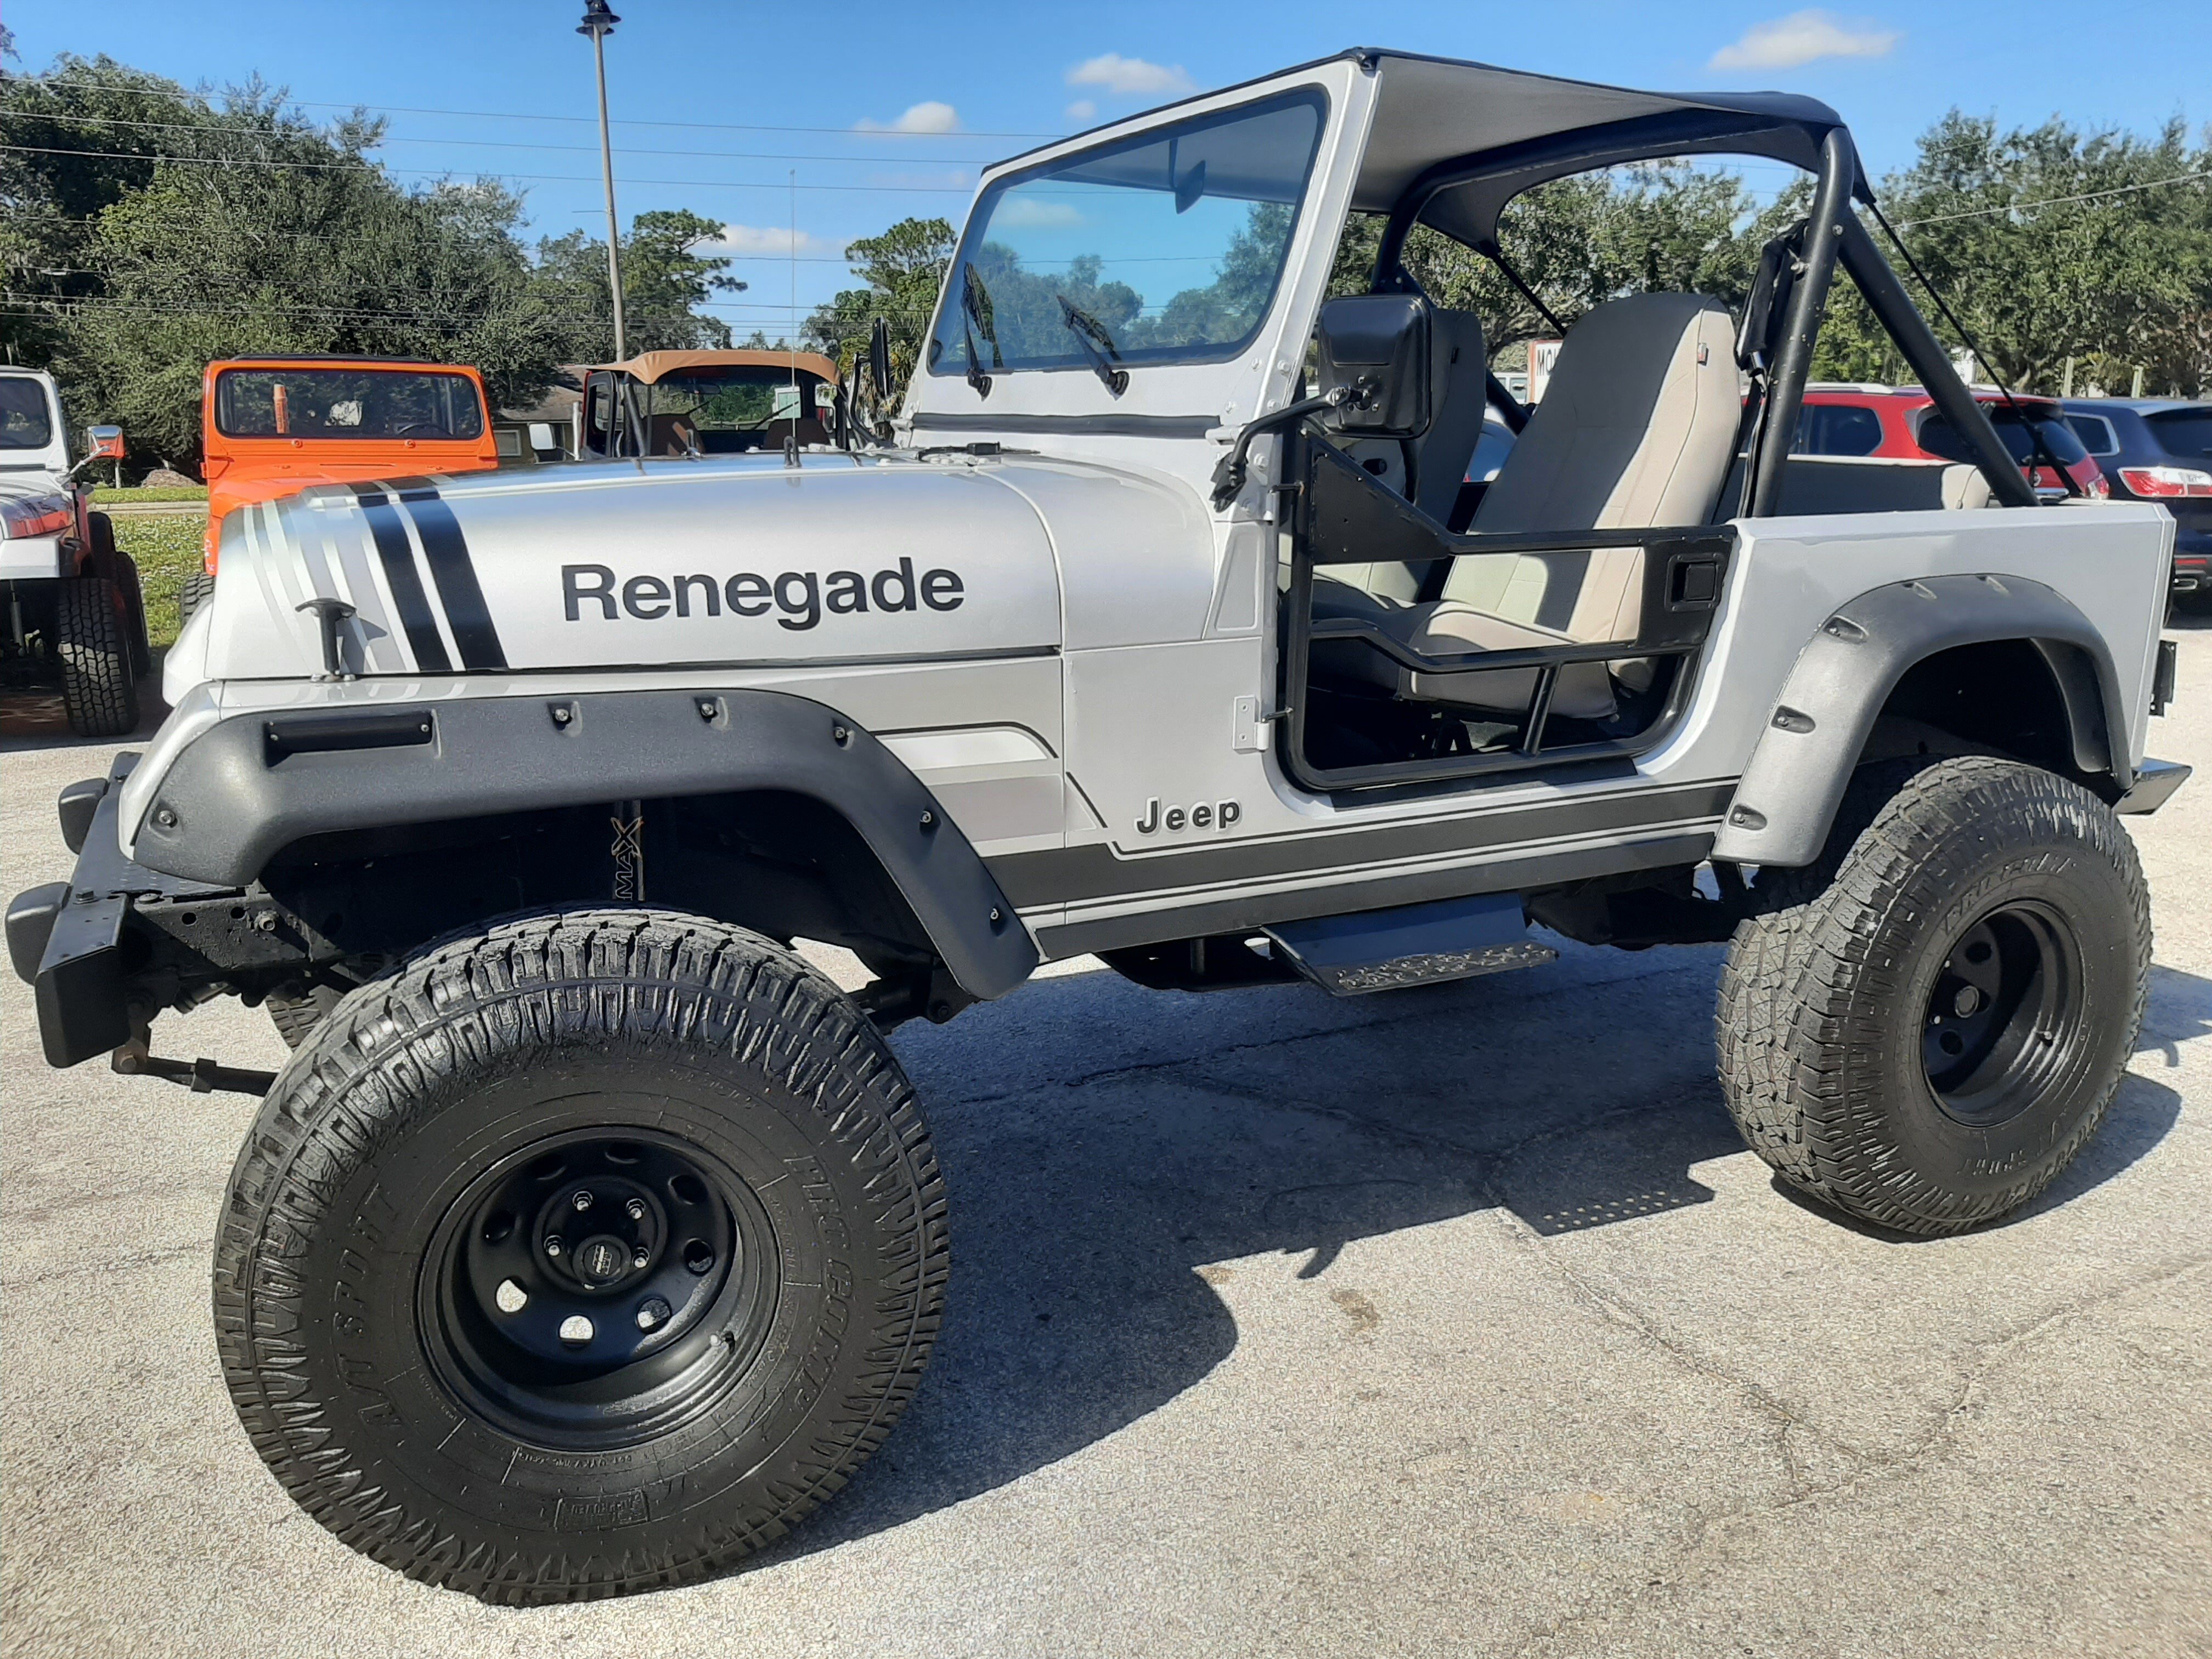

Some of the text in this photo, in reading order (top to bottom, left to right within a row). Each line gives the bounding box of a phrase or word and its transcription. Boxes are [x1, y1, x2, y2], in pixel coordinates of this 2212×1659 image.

[561, 557, 965, 631] Renegade
[1135, 799, 1241, 834] Jeep
[610, 816, 643, 900] MAX
